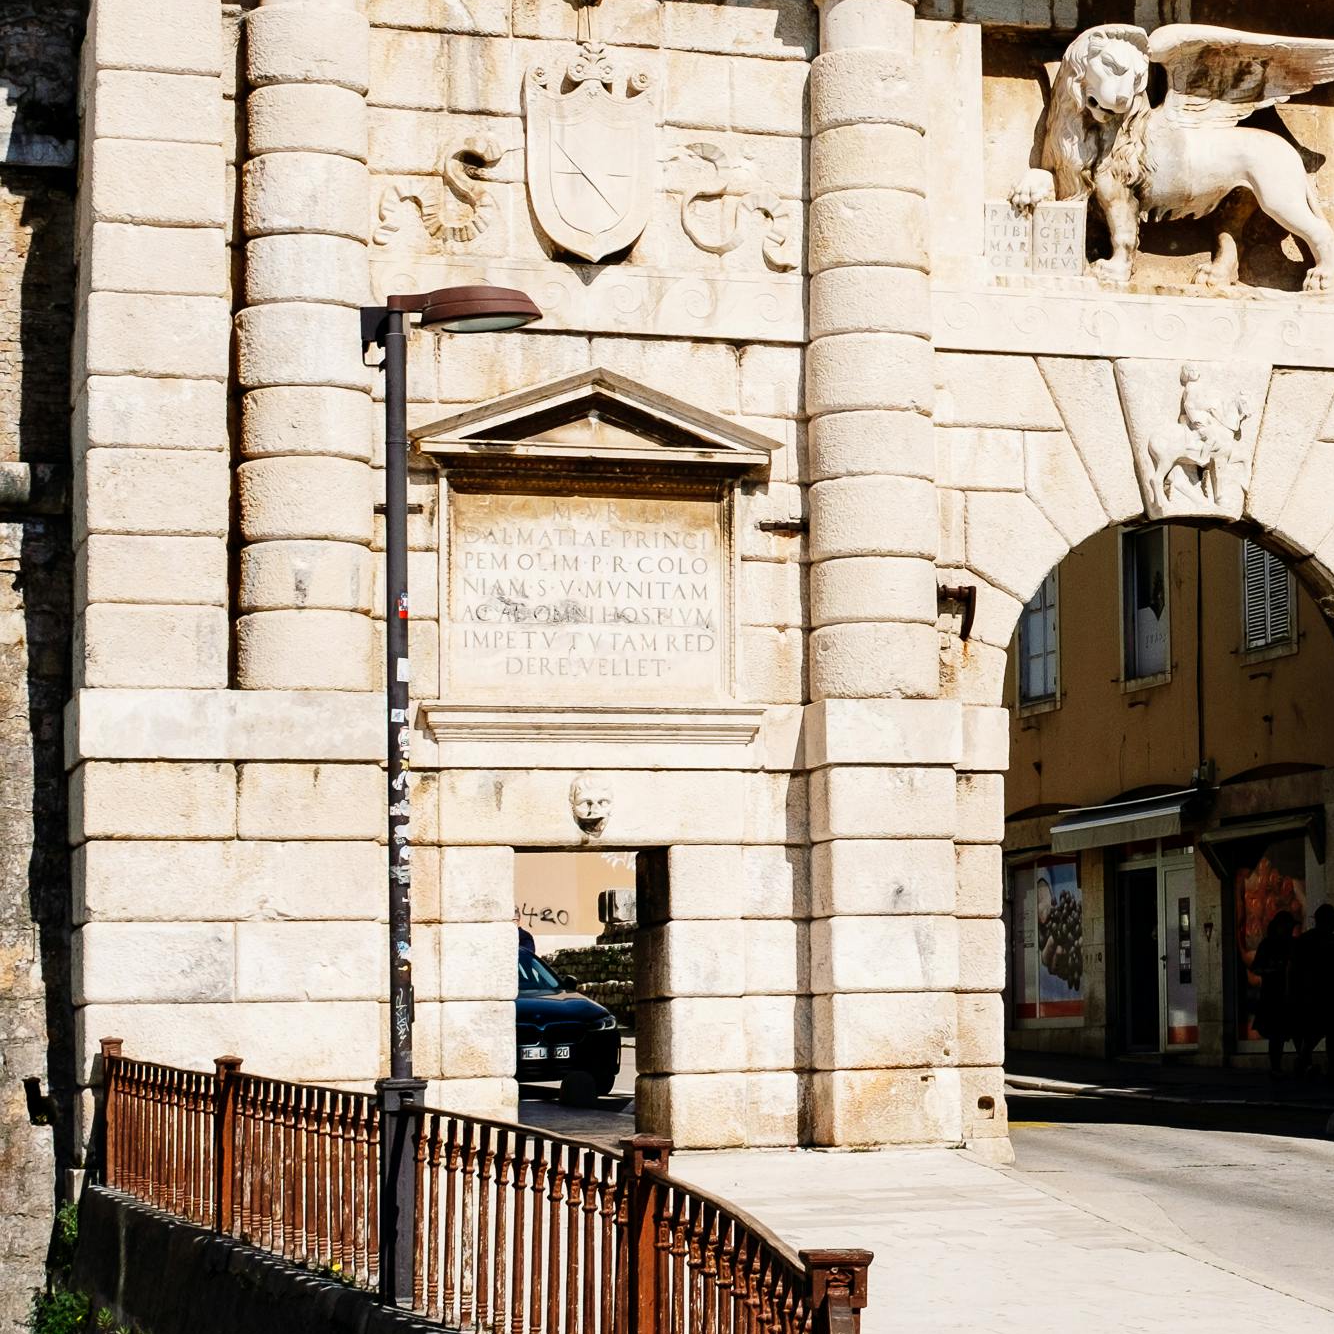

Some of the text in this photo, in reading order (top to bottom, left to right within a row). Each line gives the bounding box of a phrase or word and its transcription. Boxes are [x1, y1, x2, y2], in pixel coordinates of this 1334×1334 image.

[991, 225, 1027, 237] TIBI
[990, 240, 1028, 252] MAR
[1042, 242, 1074, 255] STA
[1037, 257, 1078, 269] MEVS
[463, 527, 706, 549] DALMATIAE PRINCI
[463, 551, 508, 571] PEM
[637, 556, 708, 574] COLO
[585, 580, 708, 600] MVNITAM
[463, 630, 557, 650] IMPETV
[667, 633, 716, 653] RED
[505, 657, 570, 676] DERE
[522, 903, 569, 928] 420
